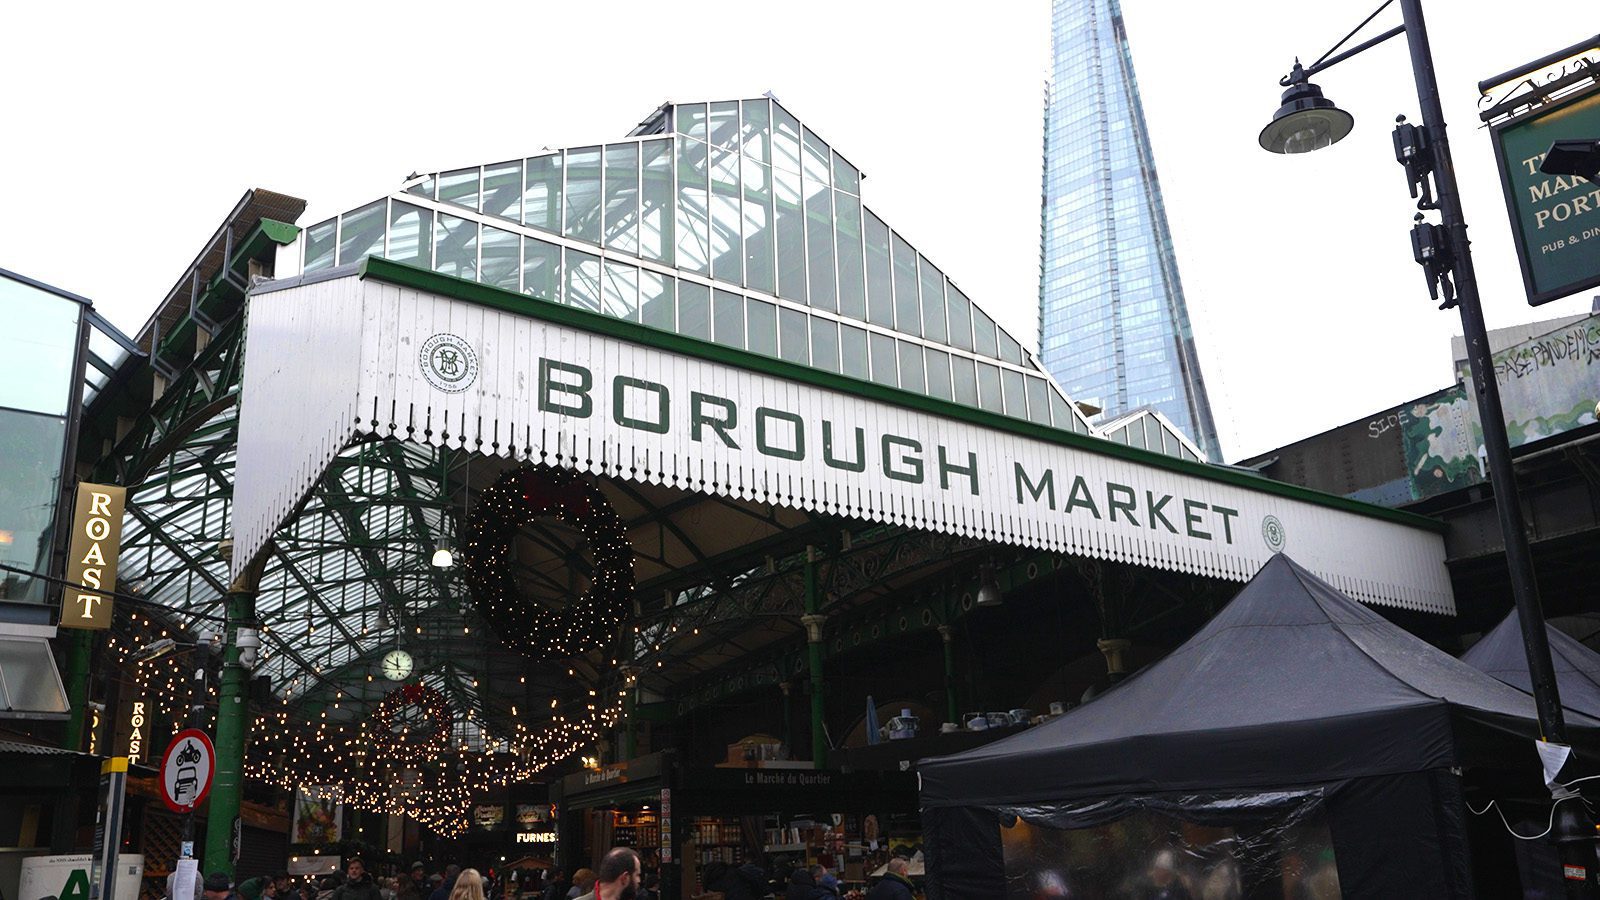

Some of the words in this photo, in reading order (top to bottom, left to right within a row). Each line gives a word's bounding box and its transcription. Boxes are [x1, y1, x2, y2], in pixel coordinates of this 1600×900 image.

[1541, 240, 1565, 254] PUB
[1568, 235, 1580, 245] &
[423, 336, 453, 368] BOROUGH
[457, 341, 475, 376] MARKET
[538, 357, 980, 496] BOROUGH
[1014, 461, 1239, 545] MARKET
[76, 492, 112, 619] ROAST
[127, 702, 145, 765] ROAST
[745, 772, 754, 784] Le
[756, 772, 785, 784] Marché
[787, 773, 797, 785] du
[799, 773, 832, 786] Quartier
[516, 832, 556, 843] FURNES
